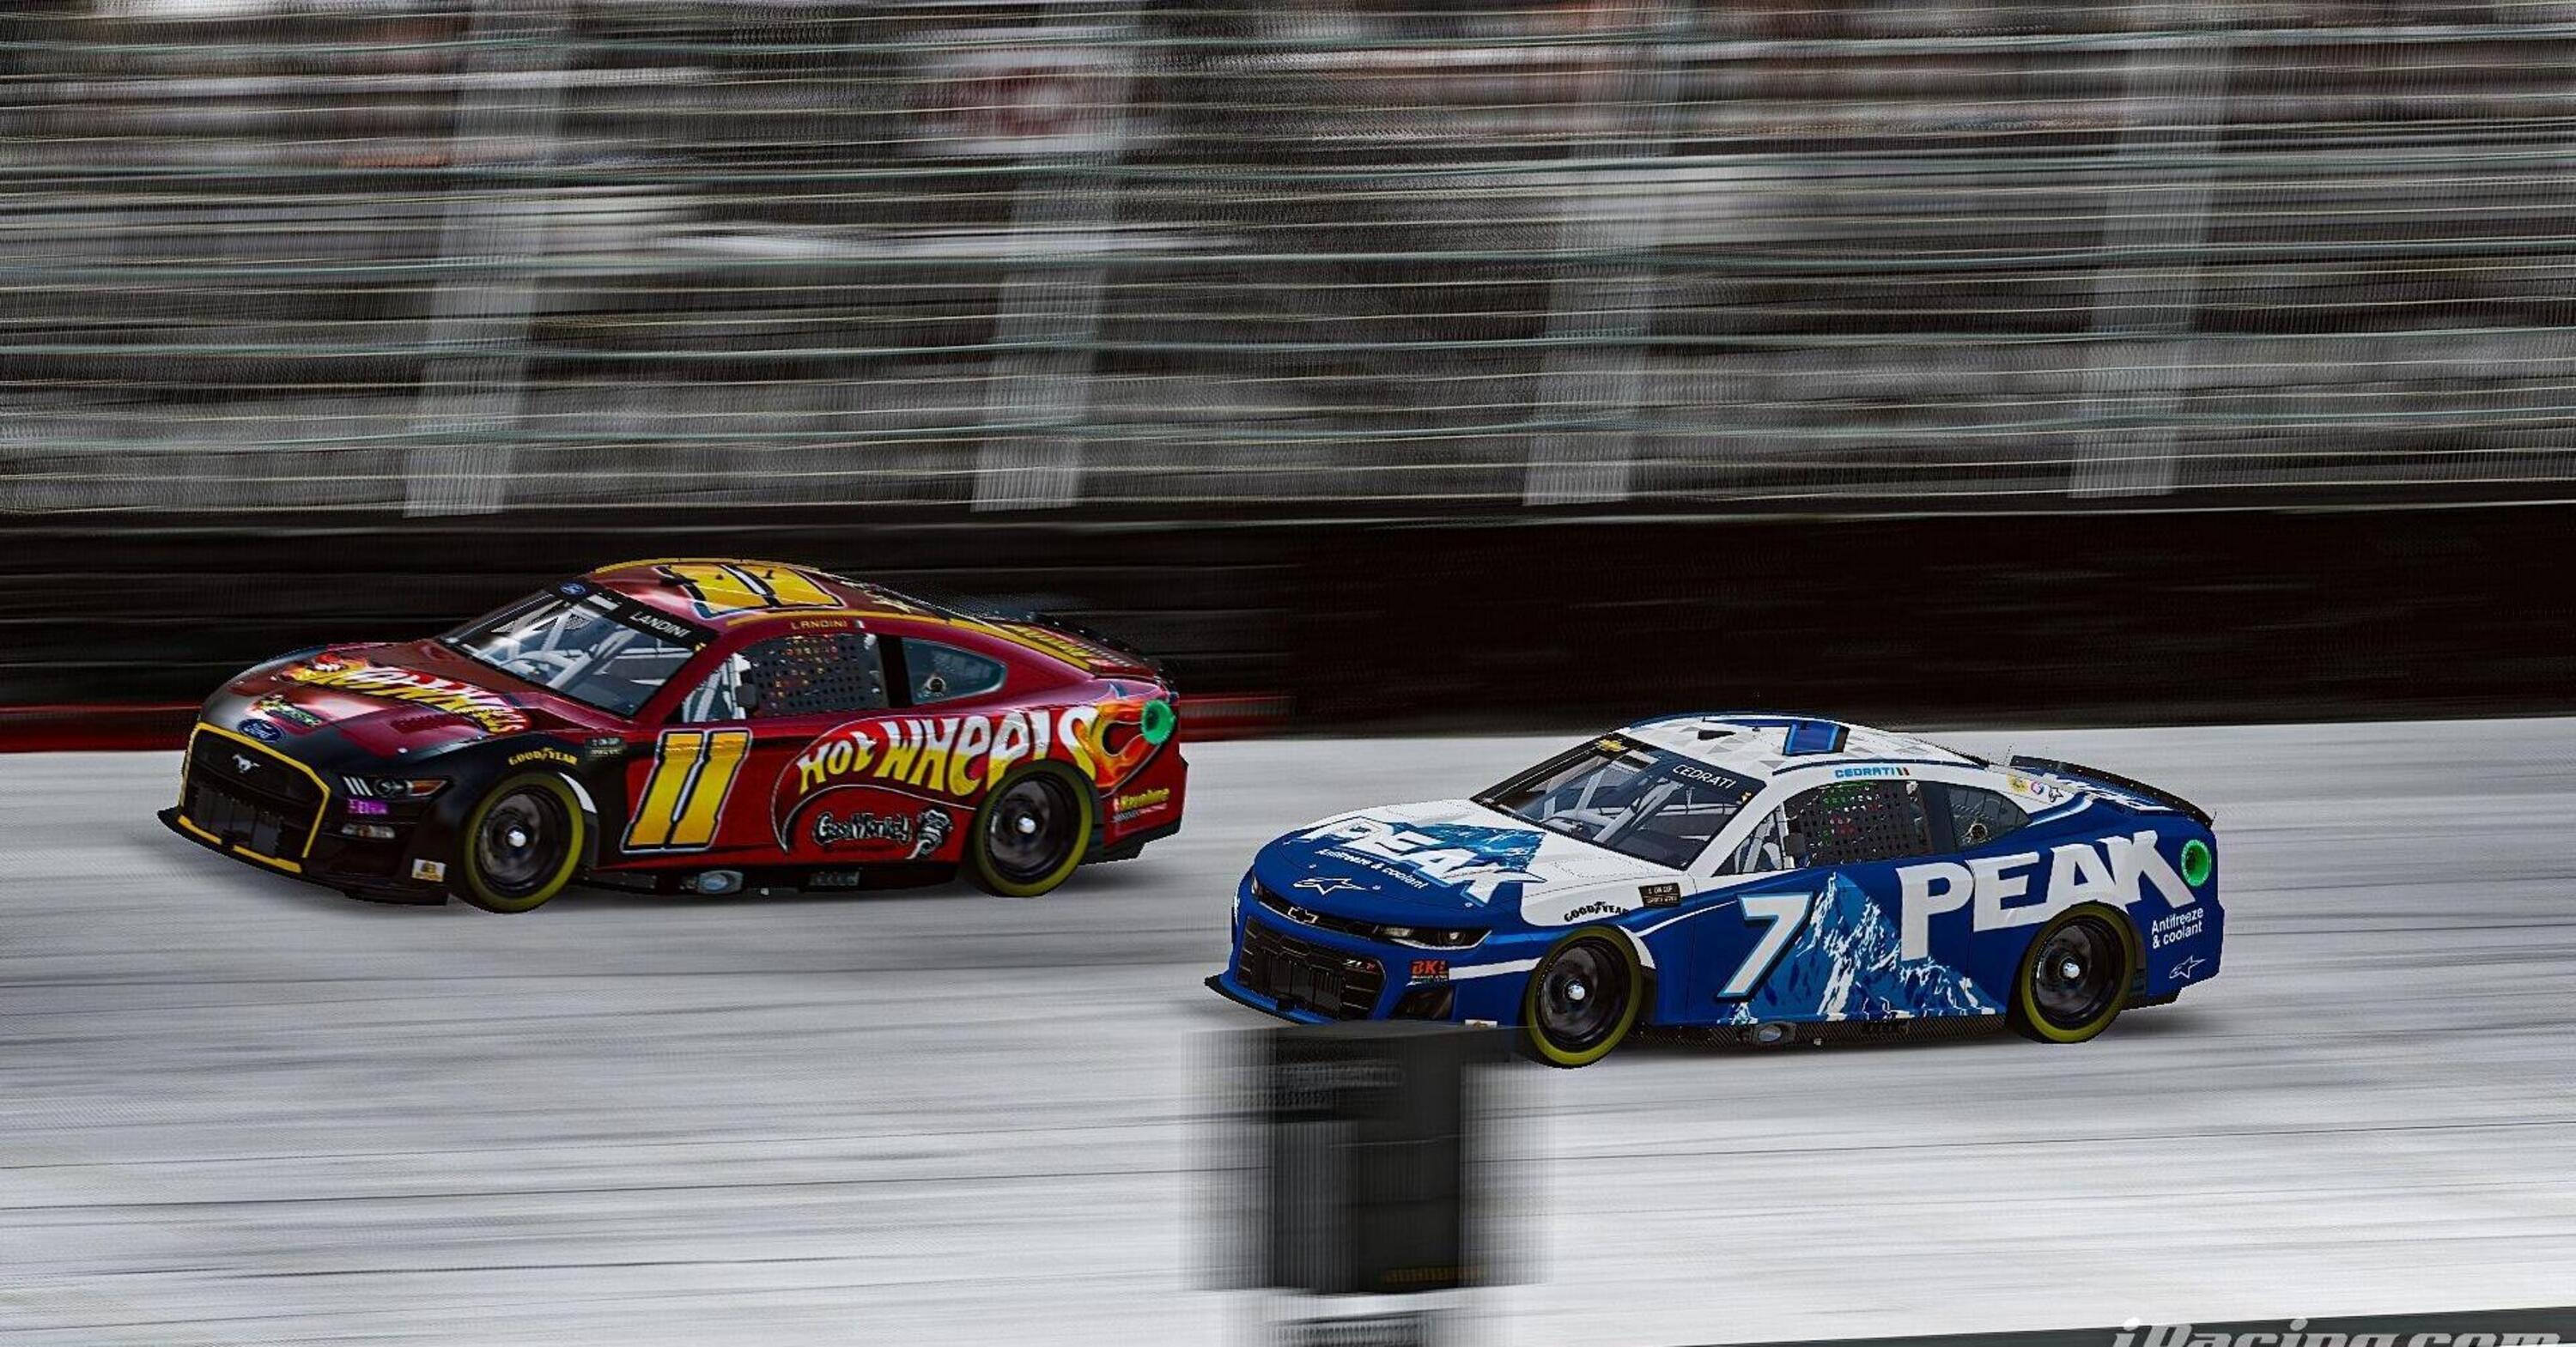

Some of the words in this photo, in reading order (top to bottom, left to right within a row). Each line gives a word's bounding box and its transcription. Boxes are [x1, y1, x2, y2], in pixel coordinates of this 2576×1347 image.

[629, 610, 692, 638] LANDINI
[790, 619, 848, 630] LANDINI
[1672, 764, 1737, 790] CEDRATI
[1834, 767, 1895, 779] CEDRATI
[620, 728, 751, 852] 11
[1293, 817, 1547, 907] PEAK
[1370, 860, 1383, 871] &
[1382, 865, 1430, 890] coolant
[1895, 829, 2196, 962] PEAK
[2151, 907, 2204, 936] Antifreeze
[2152, 934, 2161, 950] &
[2163, 919, 2203, 946] coolant
[1717, 892, 1814, 998] 7
